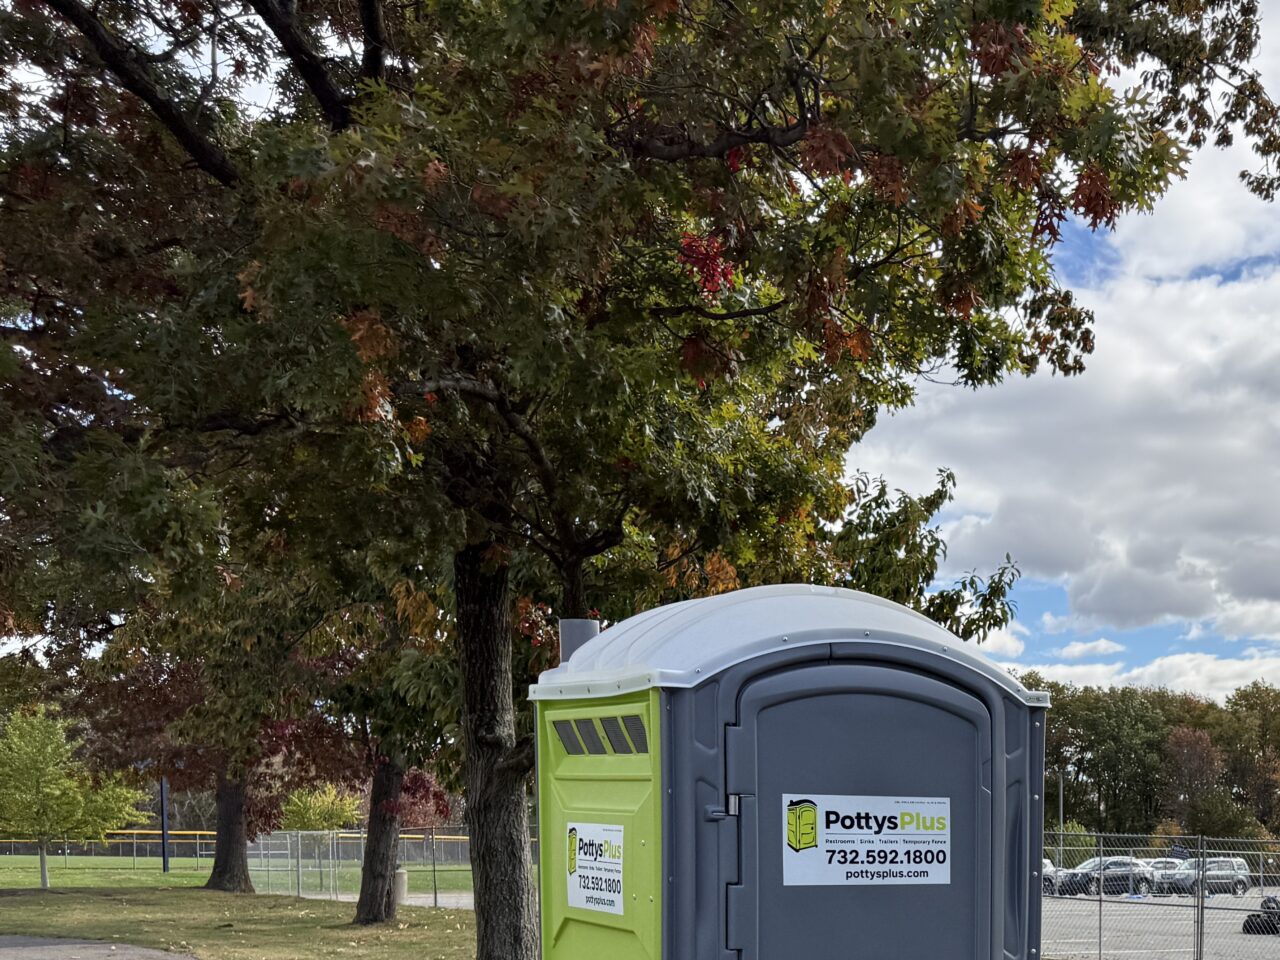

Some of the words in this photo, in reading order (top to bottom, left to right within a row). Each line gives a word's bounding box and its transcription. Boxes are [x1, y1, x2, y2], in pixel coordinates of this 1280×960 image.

[825, 810, 946, 835] PottysPlus
[578, 837, 622, 861] PottysPlus
[825, 849, 947, 864] 732.592.1800
[846, 869, 929, 880] pottysplus.com
[578, 874, 622, 895] 732.592.1800
[585, 895, 616, 908] pottysplus.com
